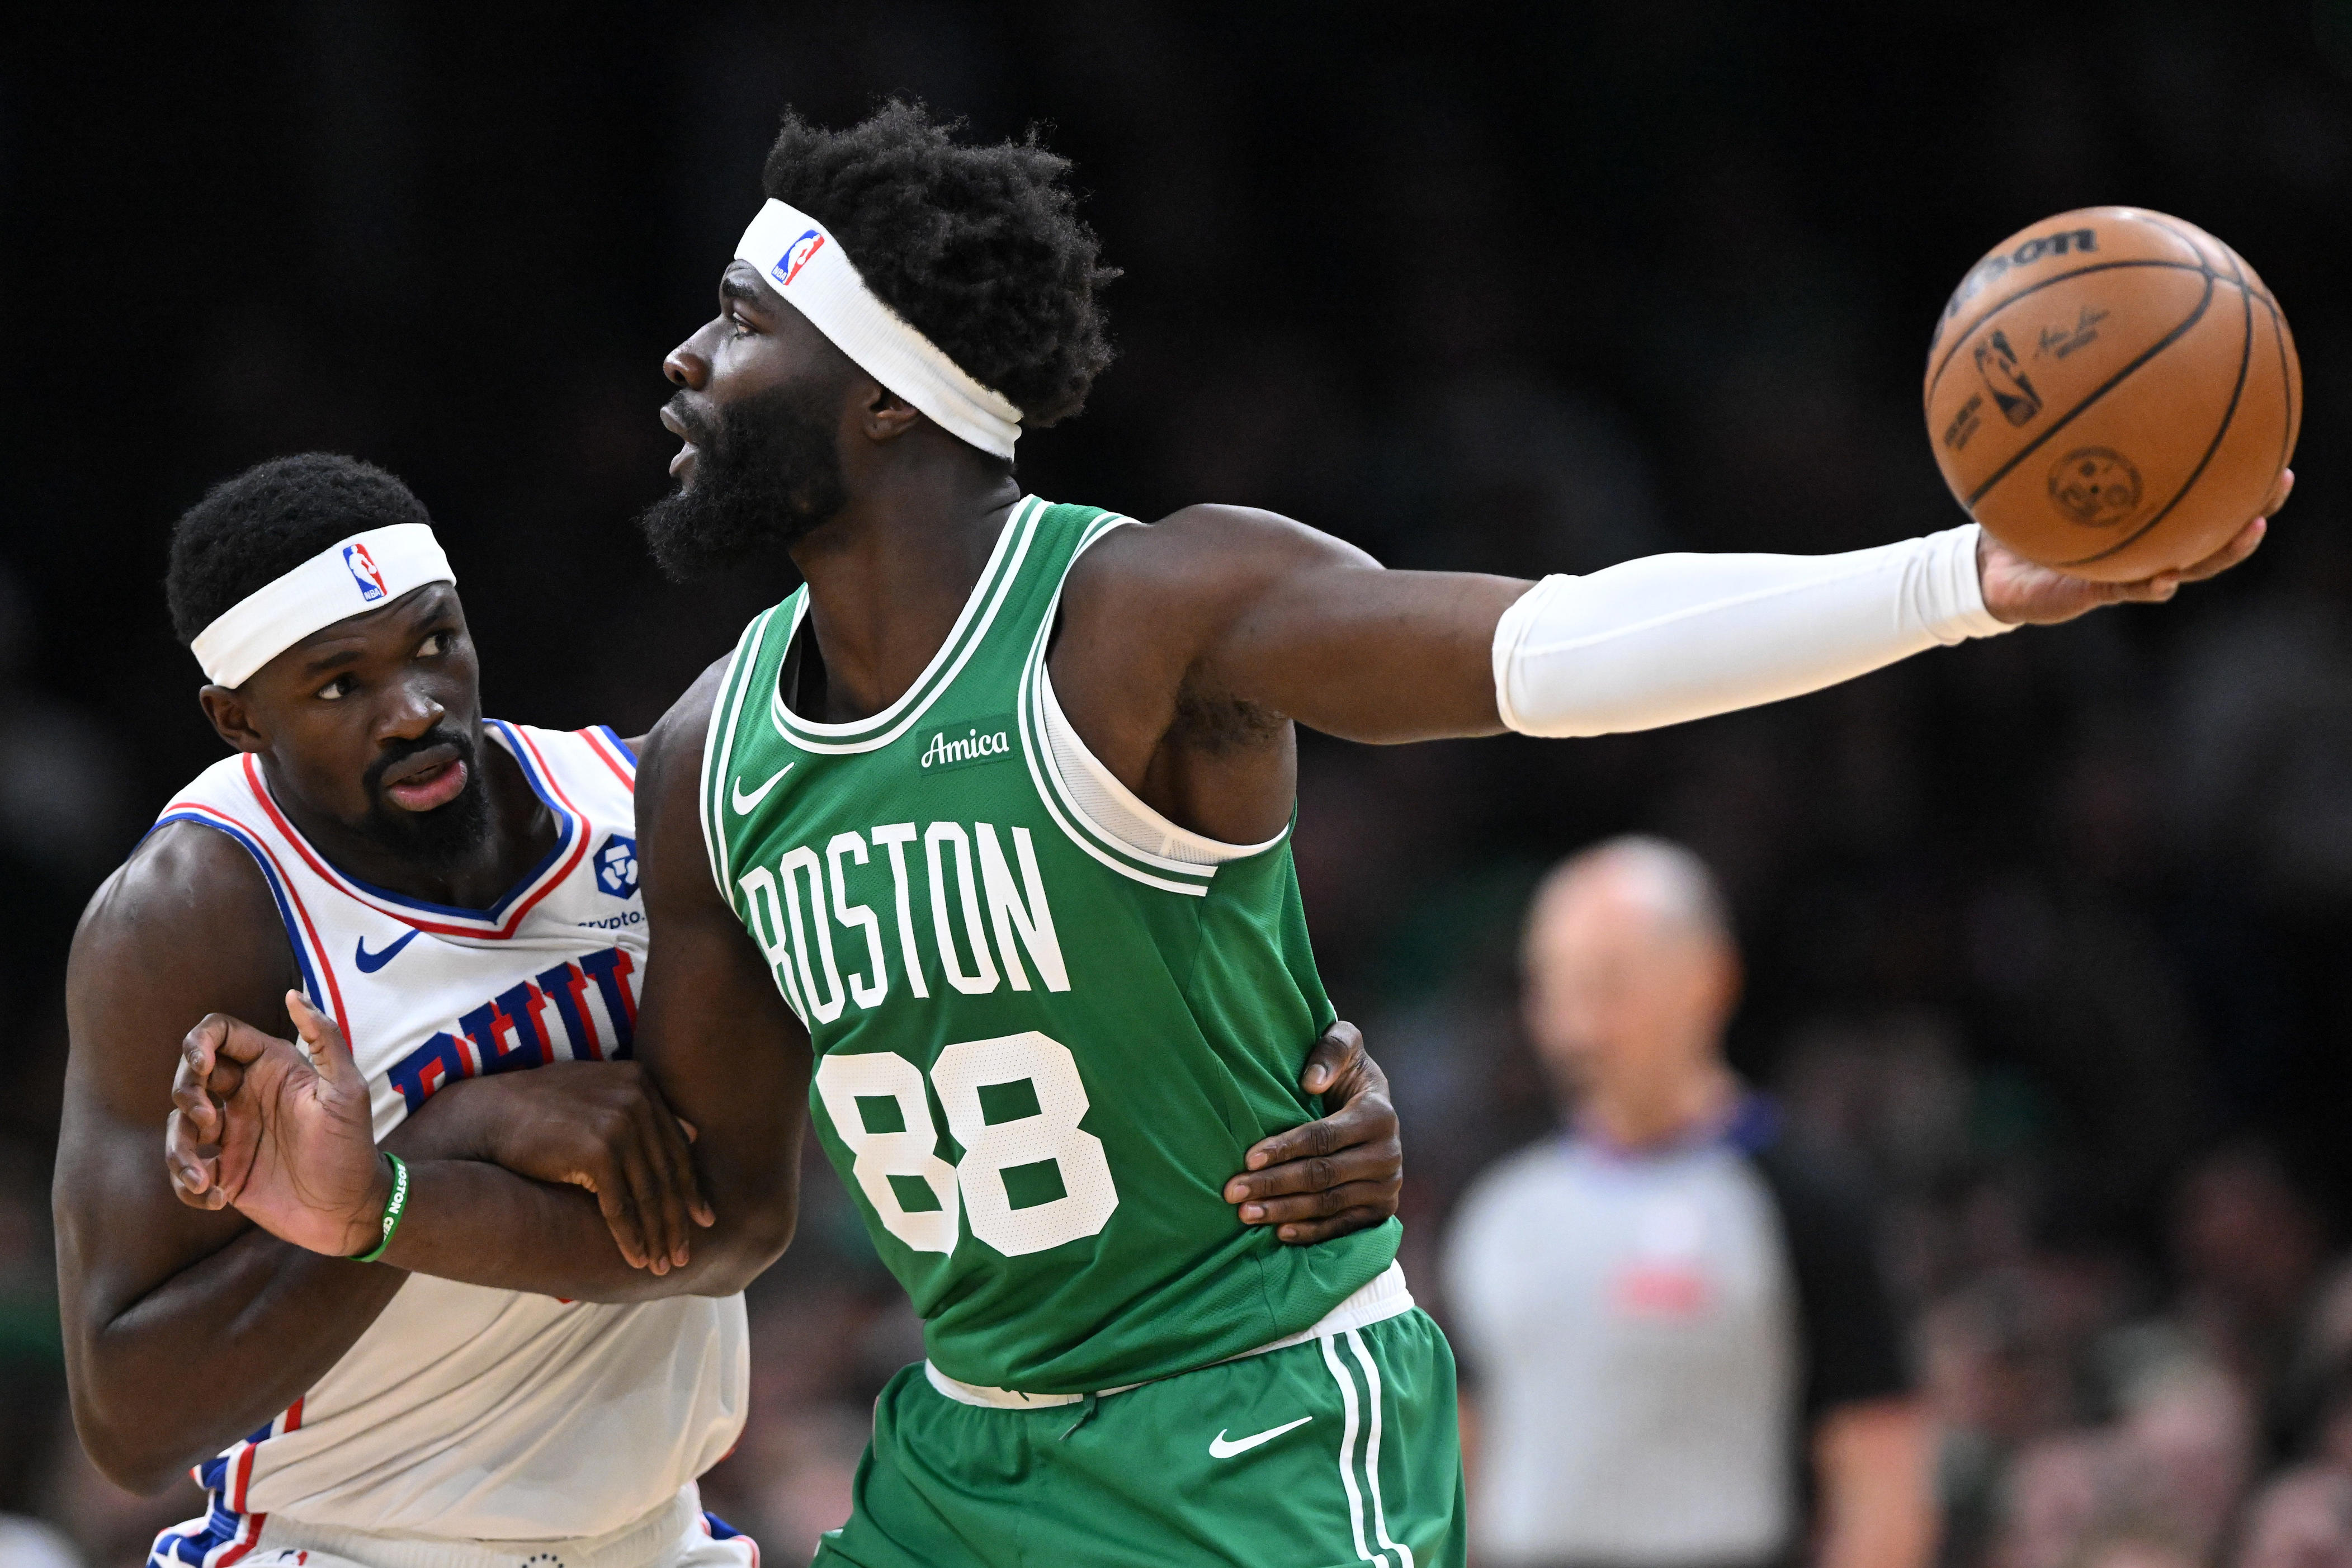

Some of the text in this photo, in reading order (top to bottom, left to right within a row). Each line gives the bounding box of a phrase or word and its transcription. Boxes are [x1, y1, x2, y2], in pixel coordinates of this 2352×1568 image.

[772, 266, 787, 281] NBA
[364, 588, 381, 600] NBA
[921, 728, 1009, 768] Amica
[738, 821, 1071, 1035] BOSTON
[815, 1031, 1120, 1258] 88
[388, 1163, 407, 1214] BOSTON
